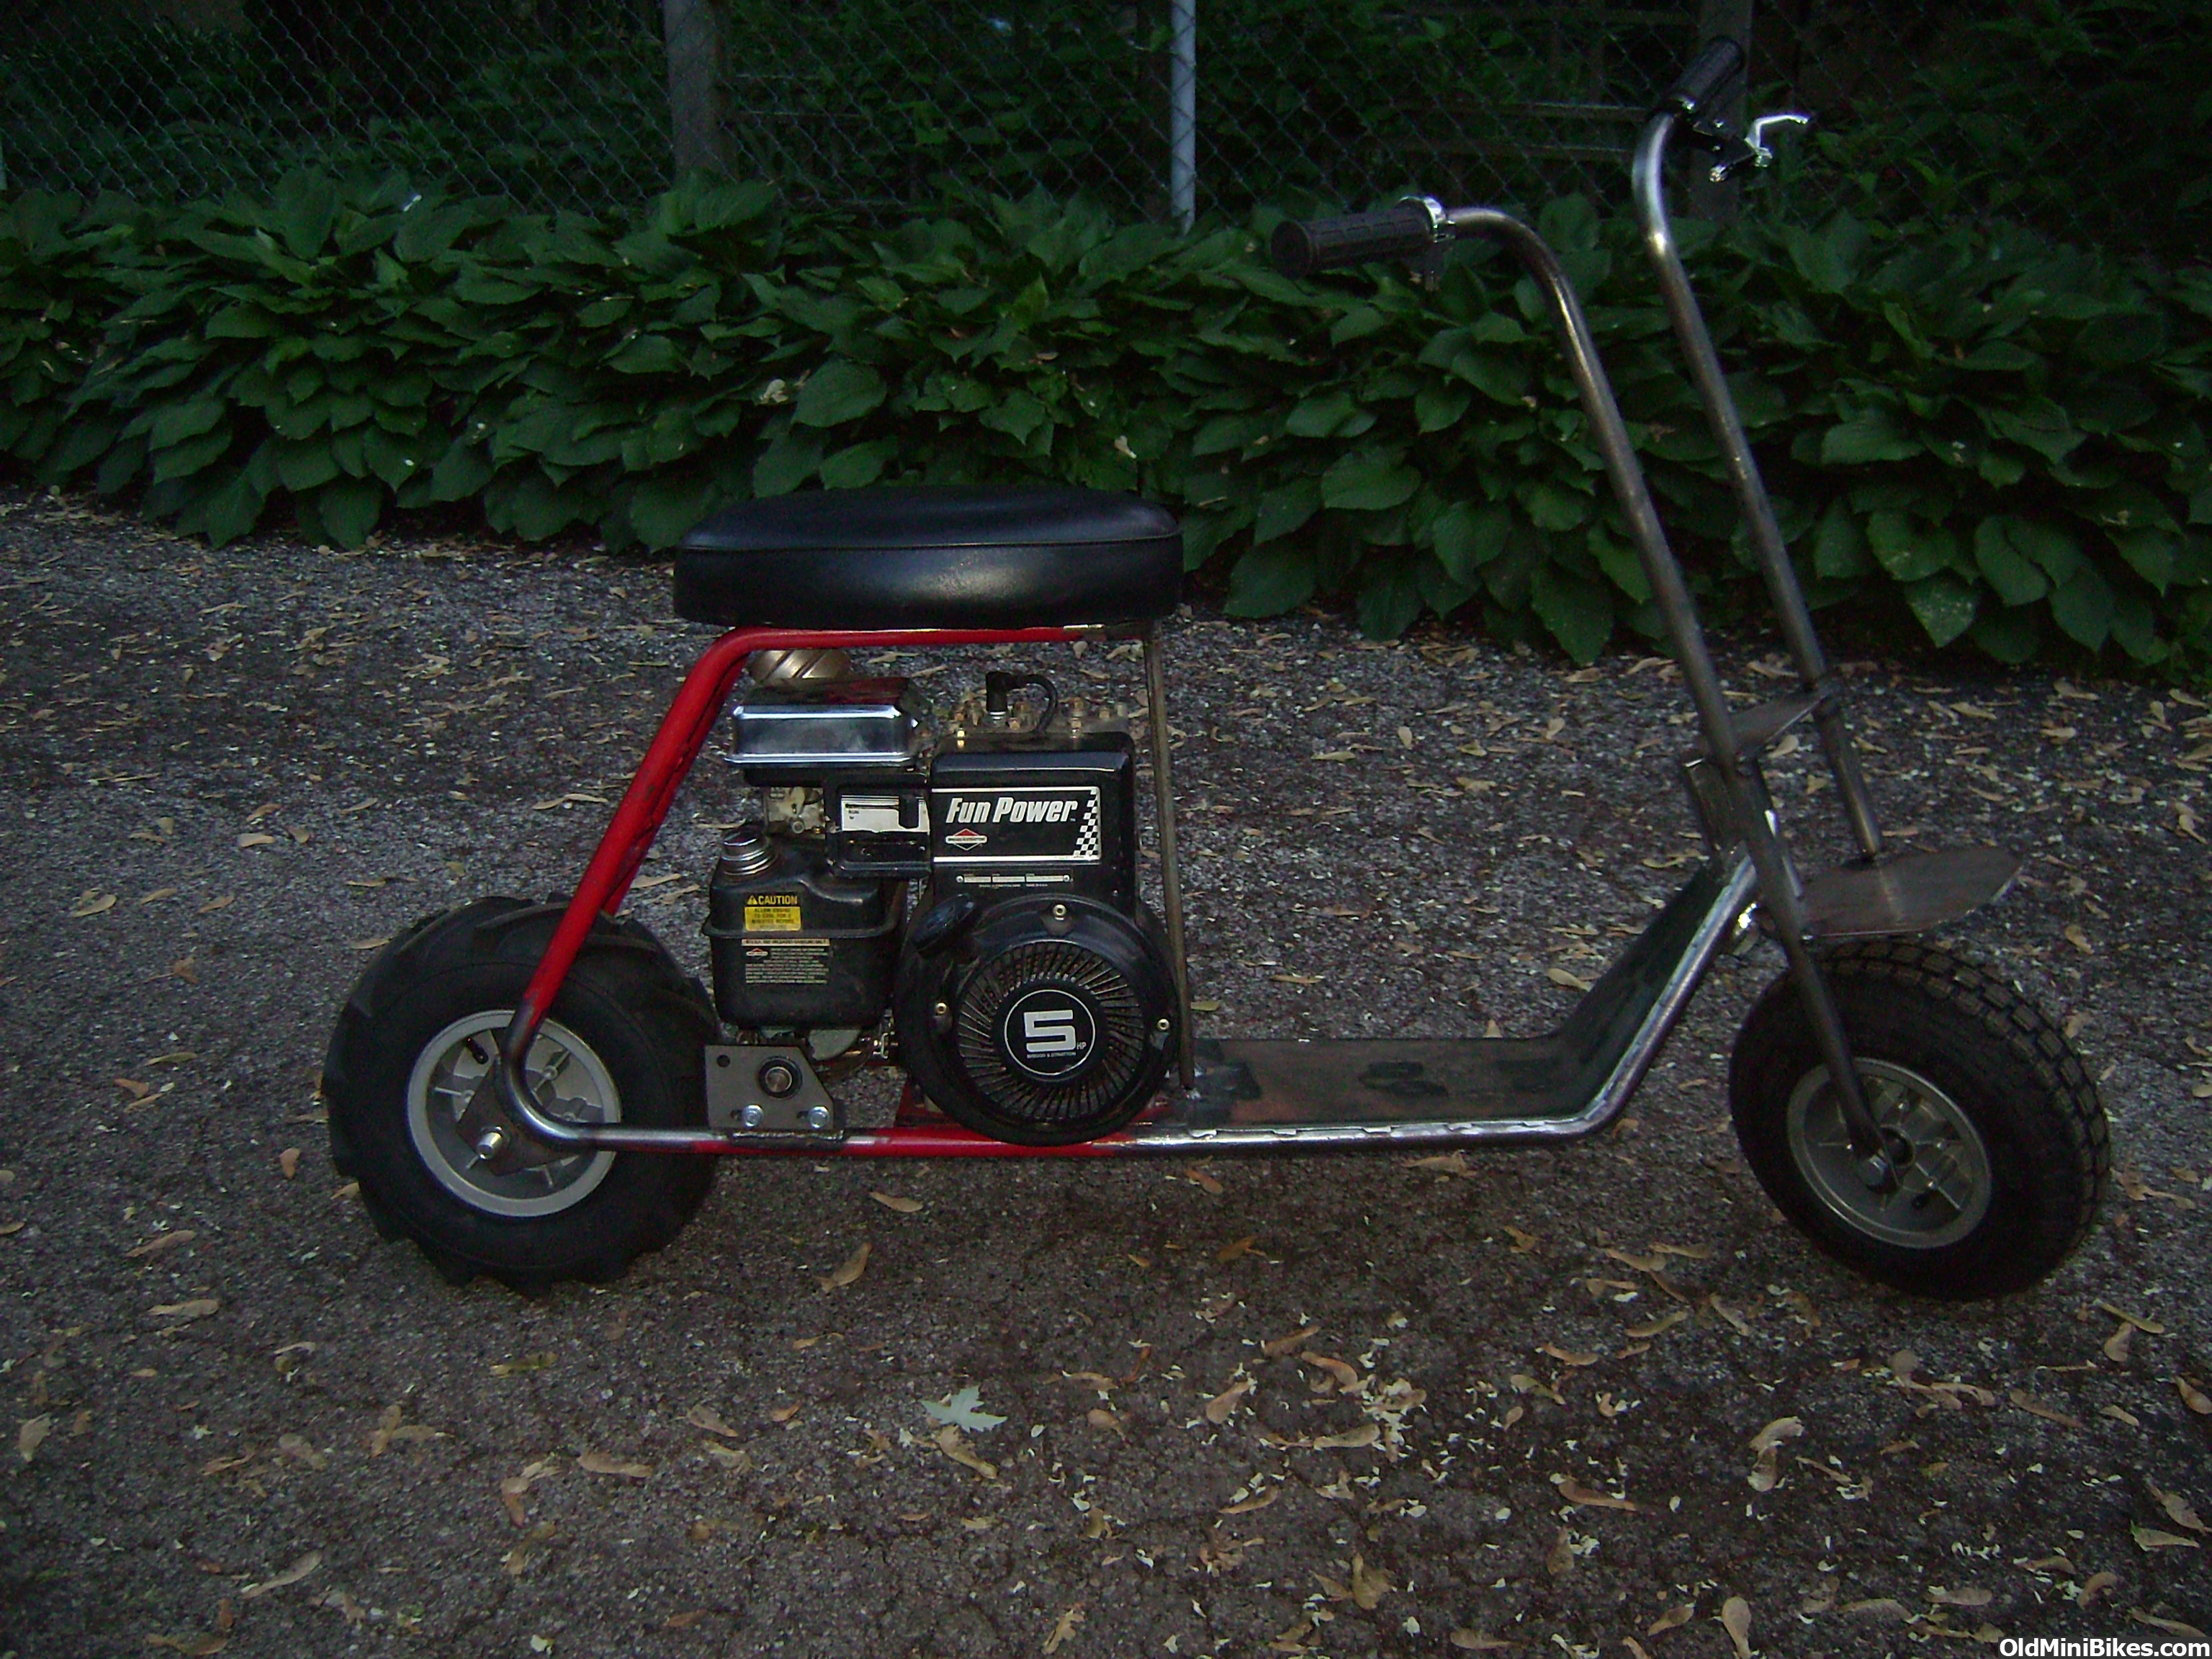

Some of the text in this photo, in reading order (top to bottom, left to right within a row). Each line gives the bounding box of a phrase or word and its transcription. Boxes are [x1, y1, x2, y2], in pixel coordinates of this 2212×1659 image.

[945, 796, 1079, 824] Fun Power
[757, 895, 798, 905] CAUTION
[1023, 1010, 1087, 1053] 5 HP
